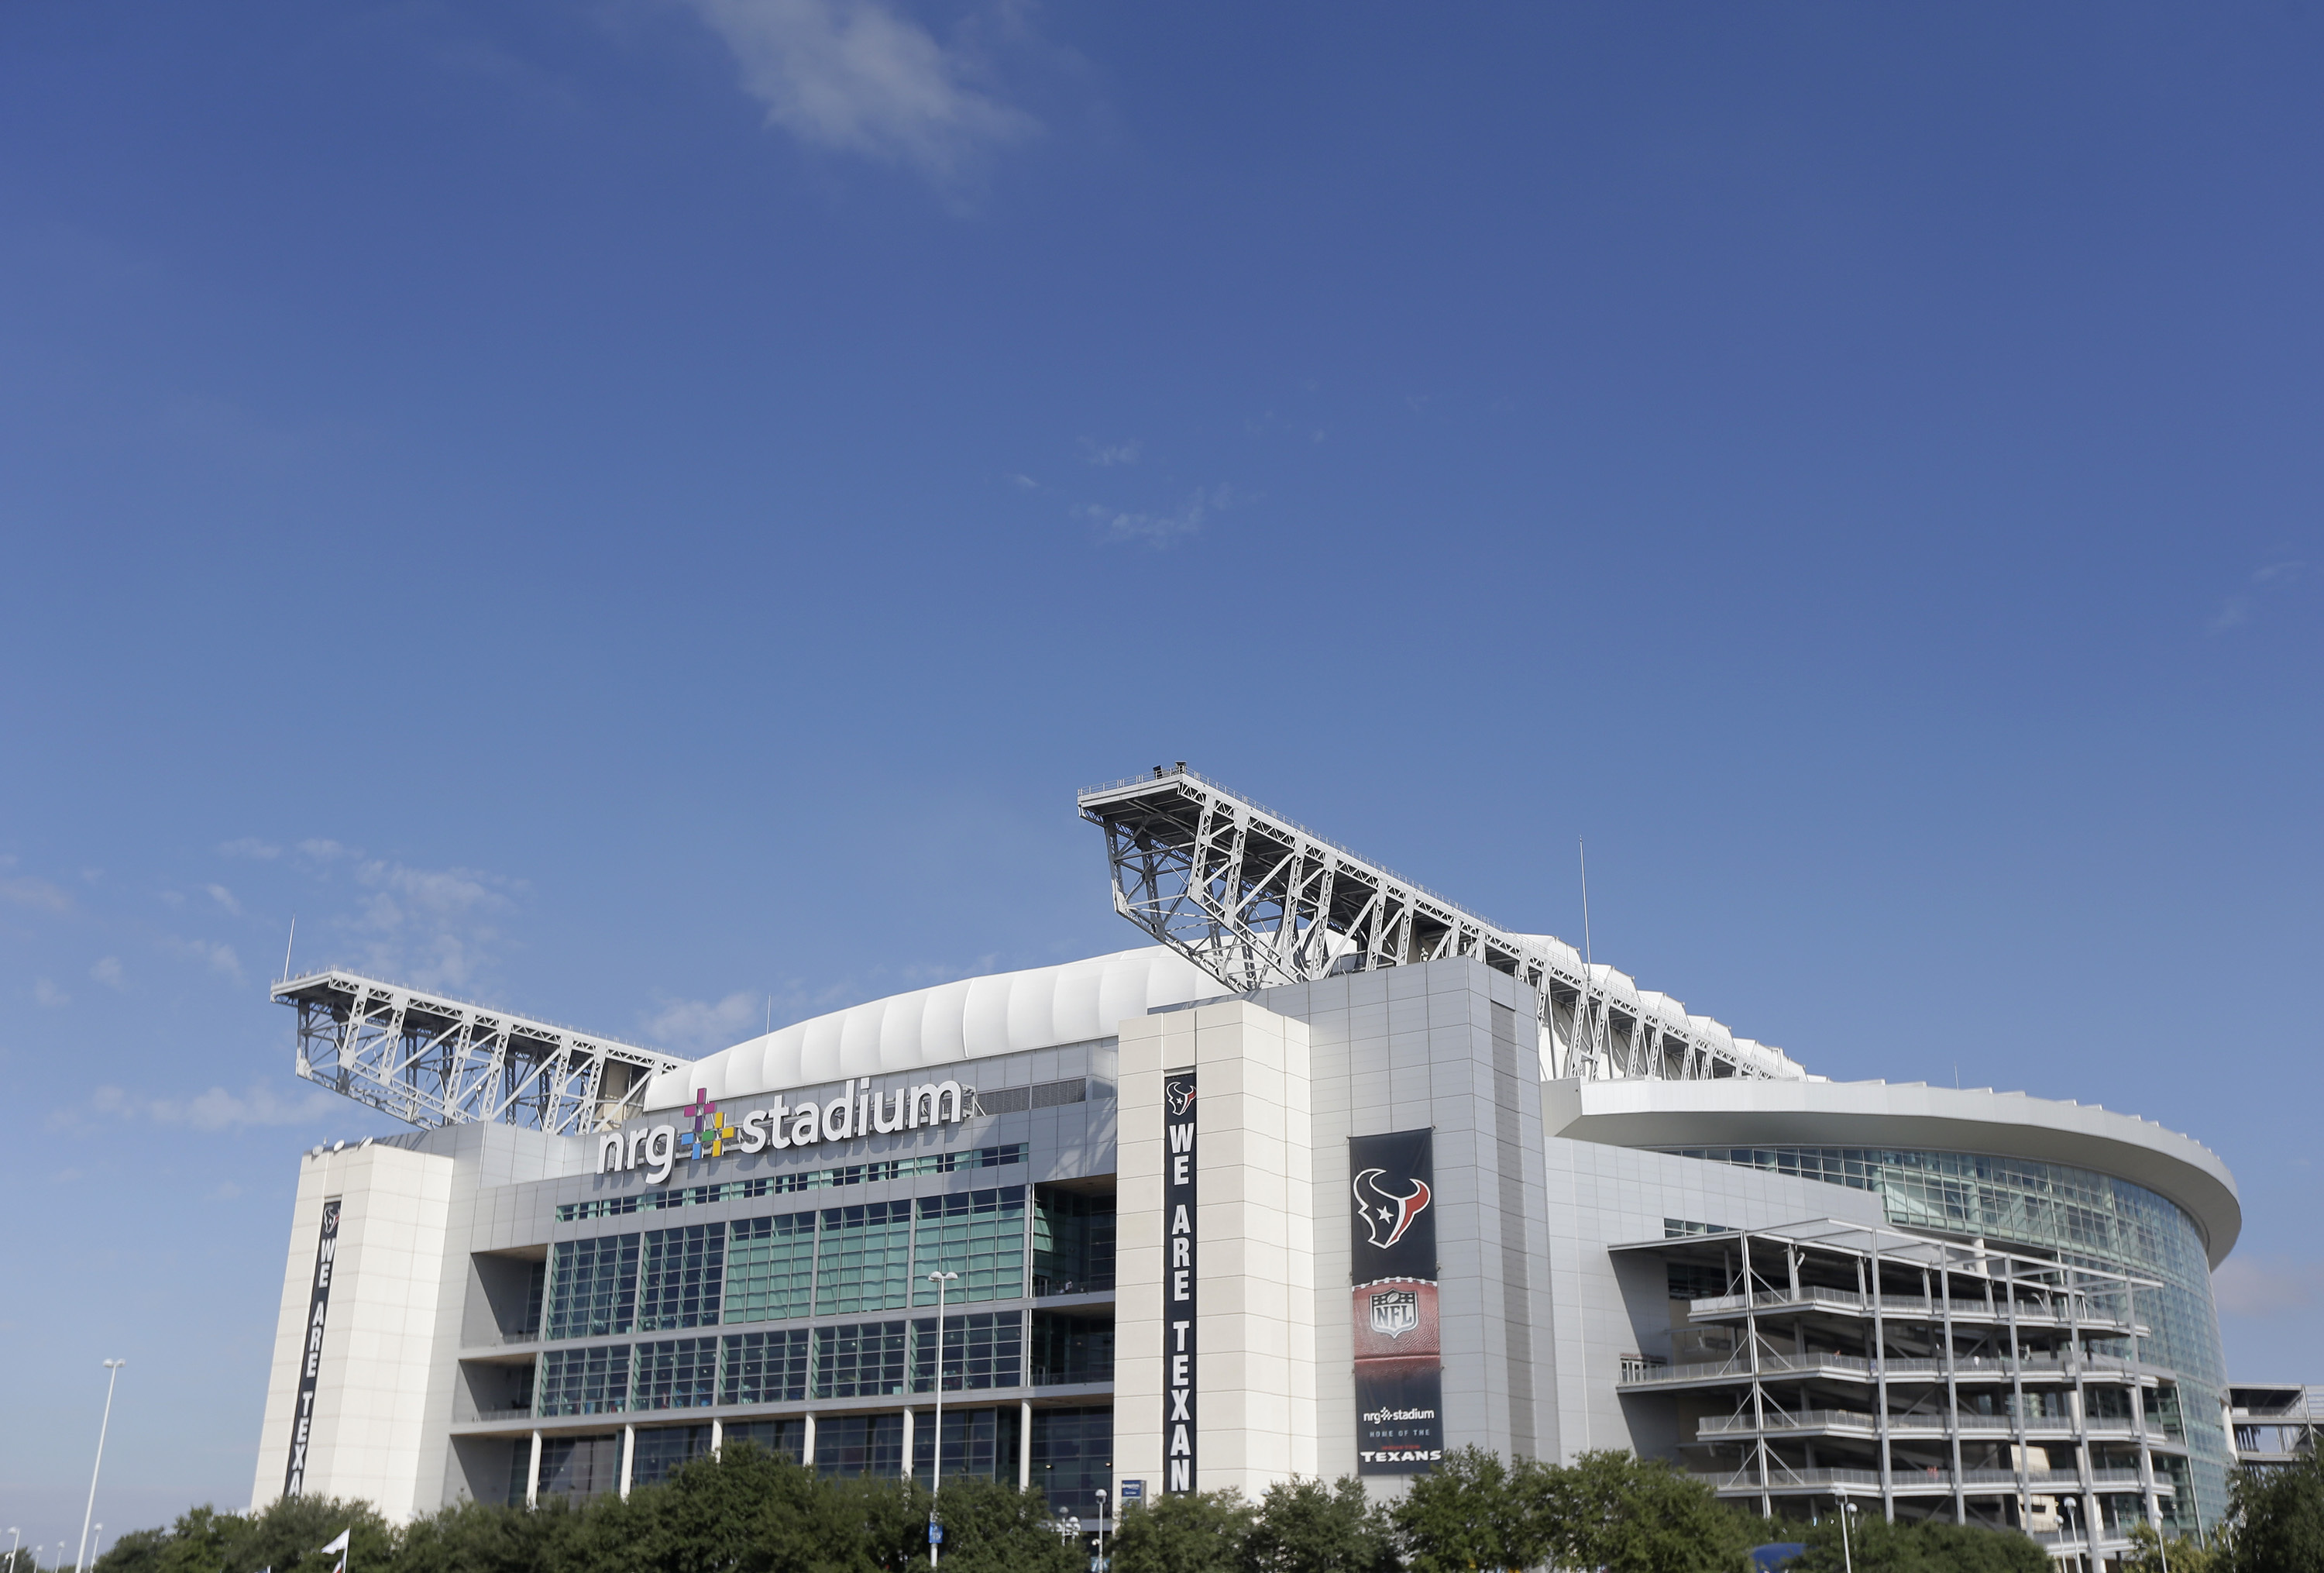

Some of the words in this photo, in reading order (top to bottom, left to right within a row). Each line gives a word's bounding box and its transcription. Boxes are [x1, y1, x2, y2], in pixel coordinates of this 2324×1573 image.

[596, 1124, 677, 1186] nrg
[739, 1076, 964, 1155] stadium
[1168, 1122, 1195, 1186] WE
[318, 1237, 337, 1289] WE
[1171, 1203, 1191, 1302] ARE
[306, 1300, 325, 1379] ARE
[1376, 1305, 1413, 1328] NFL
[1169, 1320, 1191, 1499] TEXAN
[1363, 1412, 1381, 1425] nrg
[1392, 1407, 1435, 1421] stadium
[1369, 1430, 1394, 1438] HOME
[1397, 1429, 1409, 1437] OF
[1413, 1428, 1431, 1437] THE
[287, 1390, 314, 1506] TEXA
[1360, 1449, 1442, 1463] TEXANS
